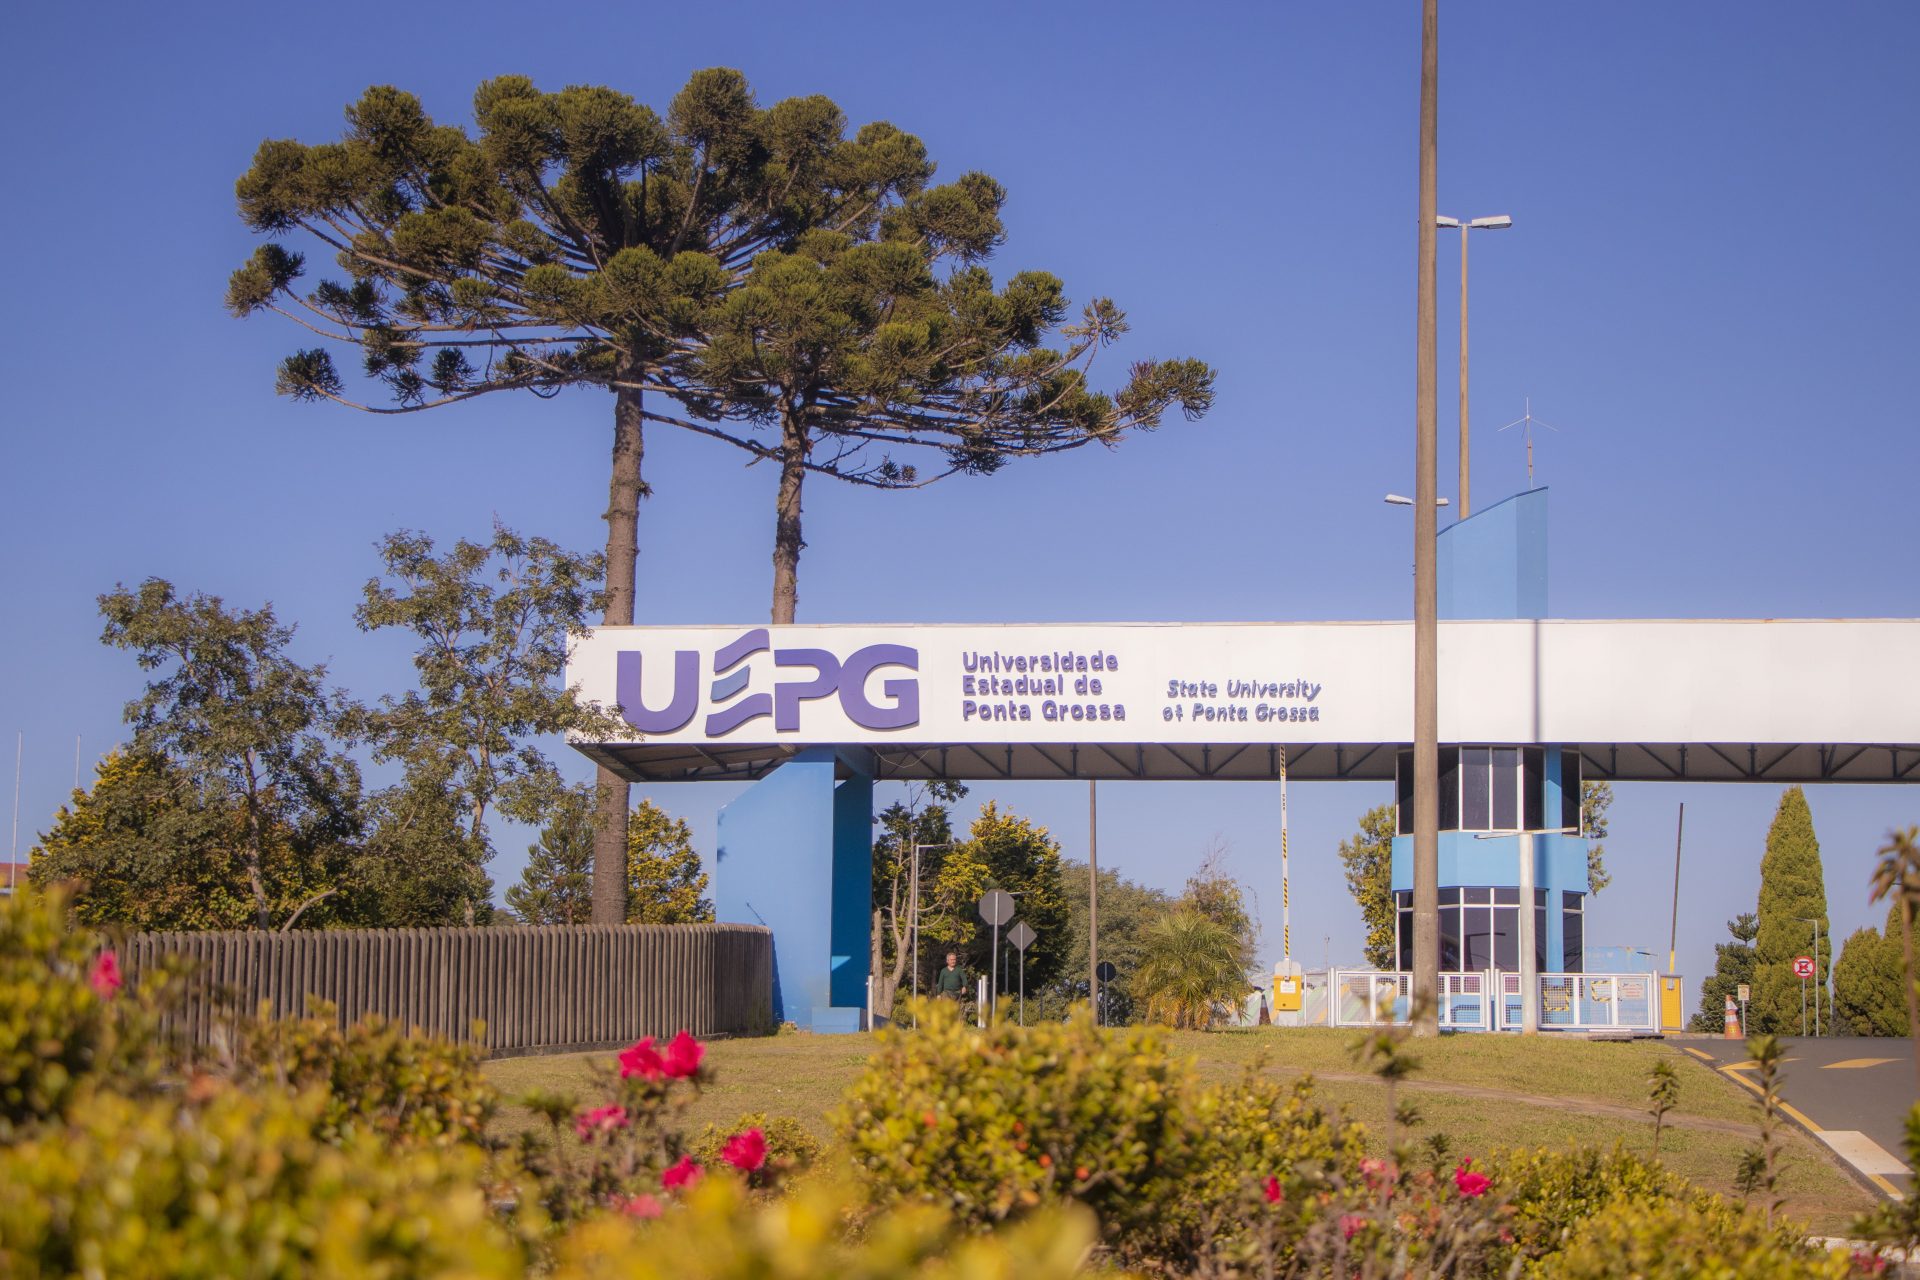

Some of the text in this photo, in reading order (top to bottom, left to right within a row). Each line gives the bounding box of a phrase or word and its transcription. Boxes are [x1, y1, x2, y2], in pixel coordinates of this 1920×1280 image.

[962, 651, 1118, 671] Universidade
[616, 629, 919, 737] UEPG
[962, 675, 1103, 695] Estadual de
[1167, 678, 1322, 701] State University
[962, 700, 1126, 721] Ponta Grossa
[1162, 703, 1320, 722] of Ponta Grossa
